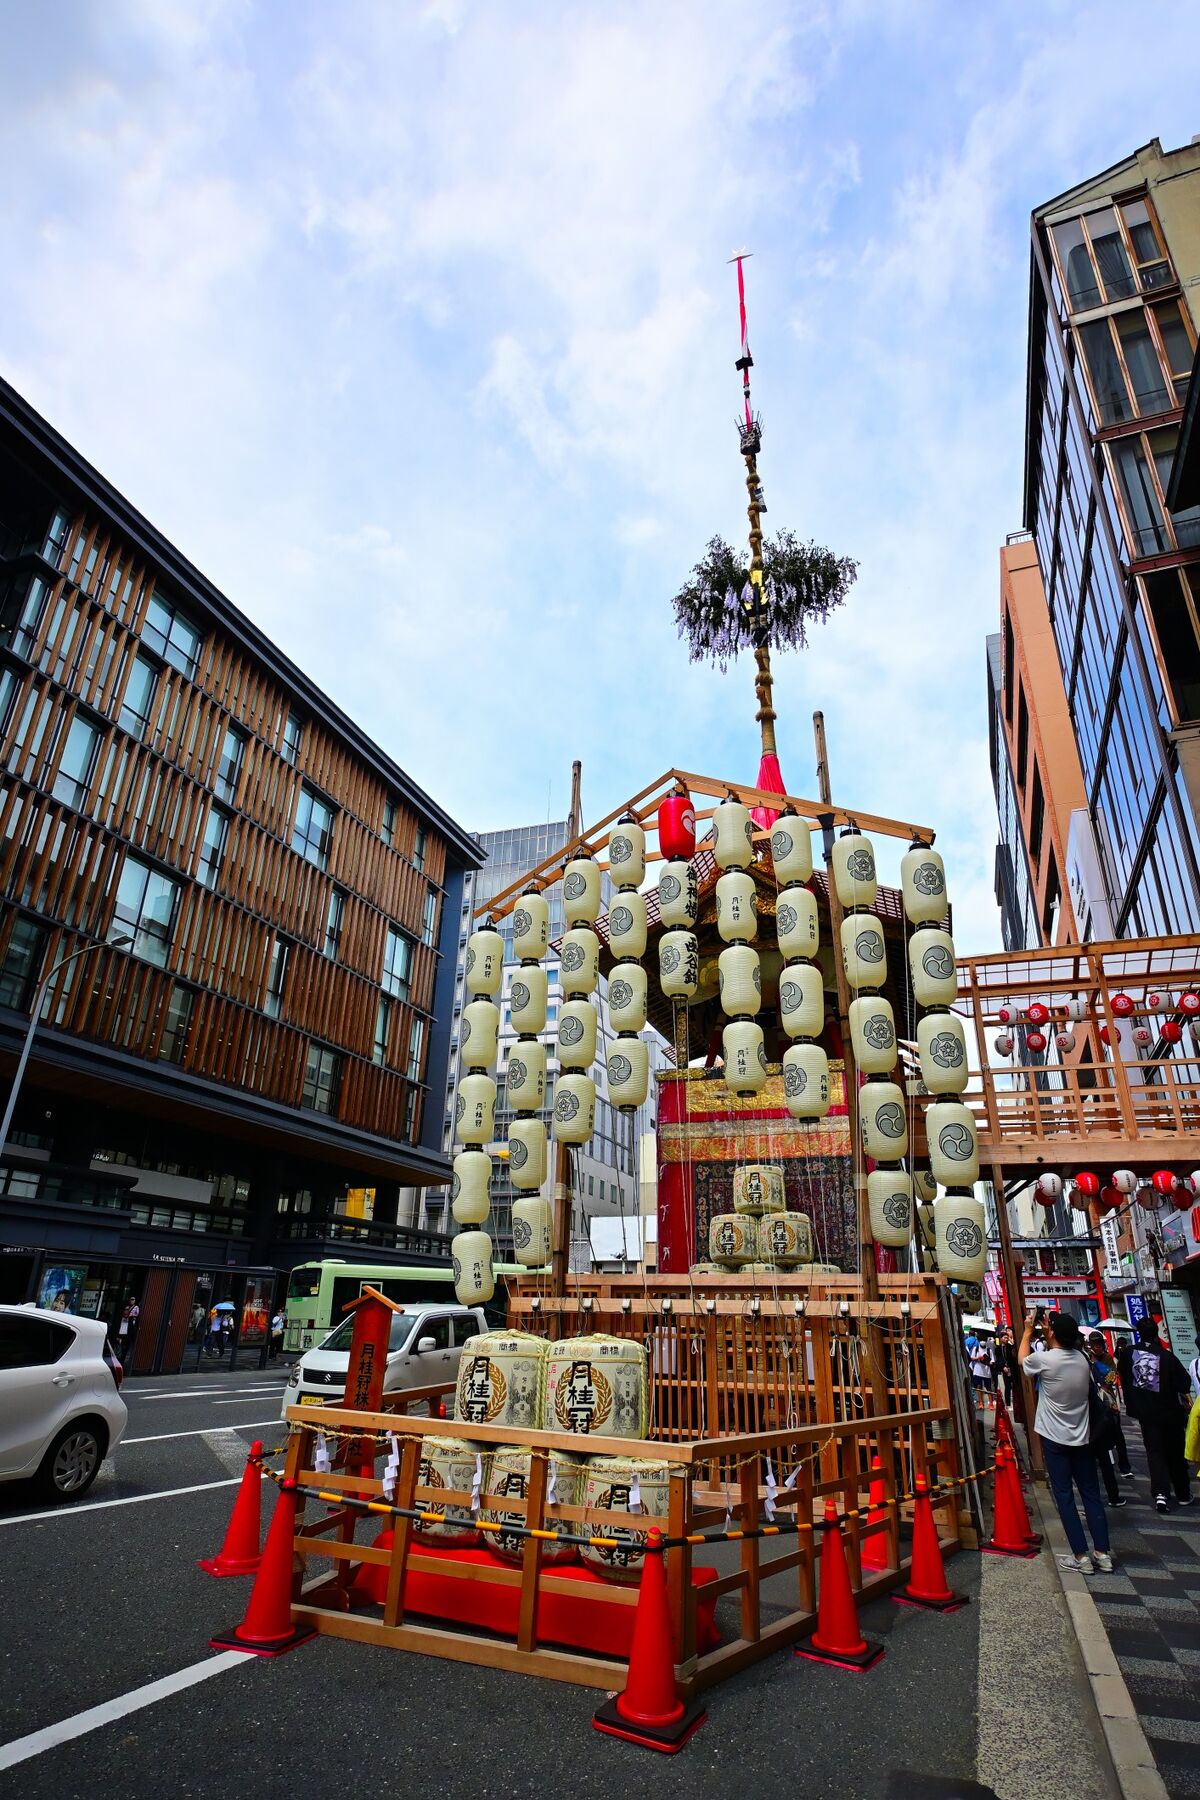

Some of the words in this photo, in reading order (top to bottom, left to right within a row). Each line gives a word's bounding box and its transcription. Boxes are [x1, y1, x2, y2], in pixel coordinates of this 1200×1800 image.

[748, 1172, 762, 1203] 月桂冠
[721, 1222, 735, 1255] 月桂冠
[773, 1221, 787, 1254] 月桂冠
[467, 1356, 490, 1423] 月桂冠
[567, 1361, 595, 1434] 月桂冠
